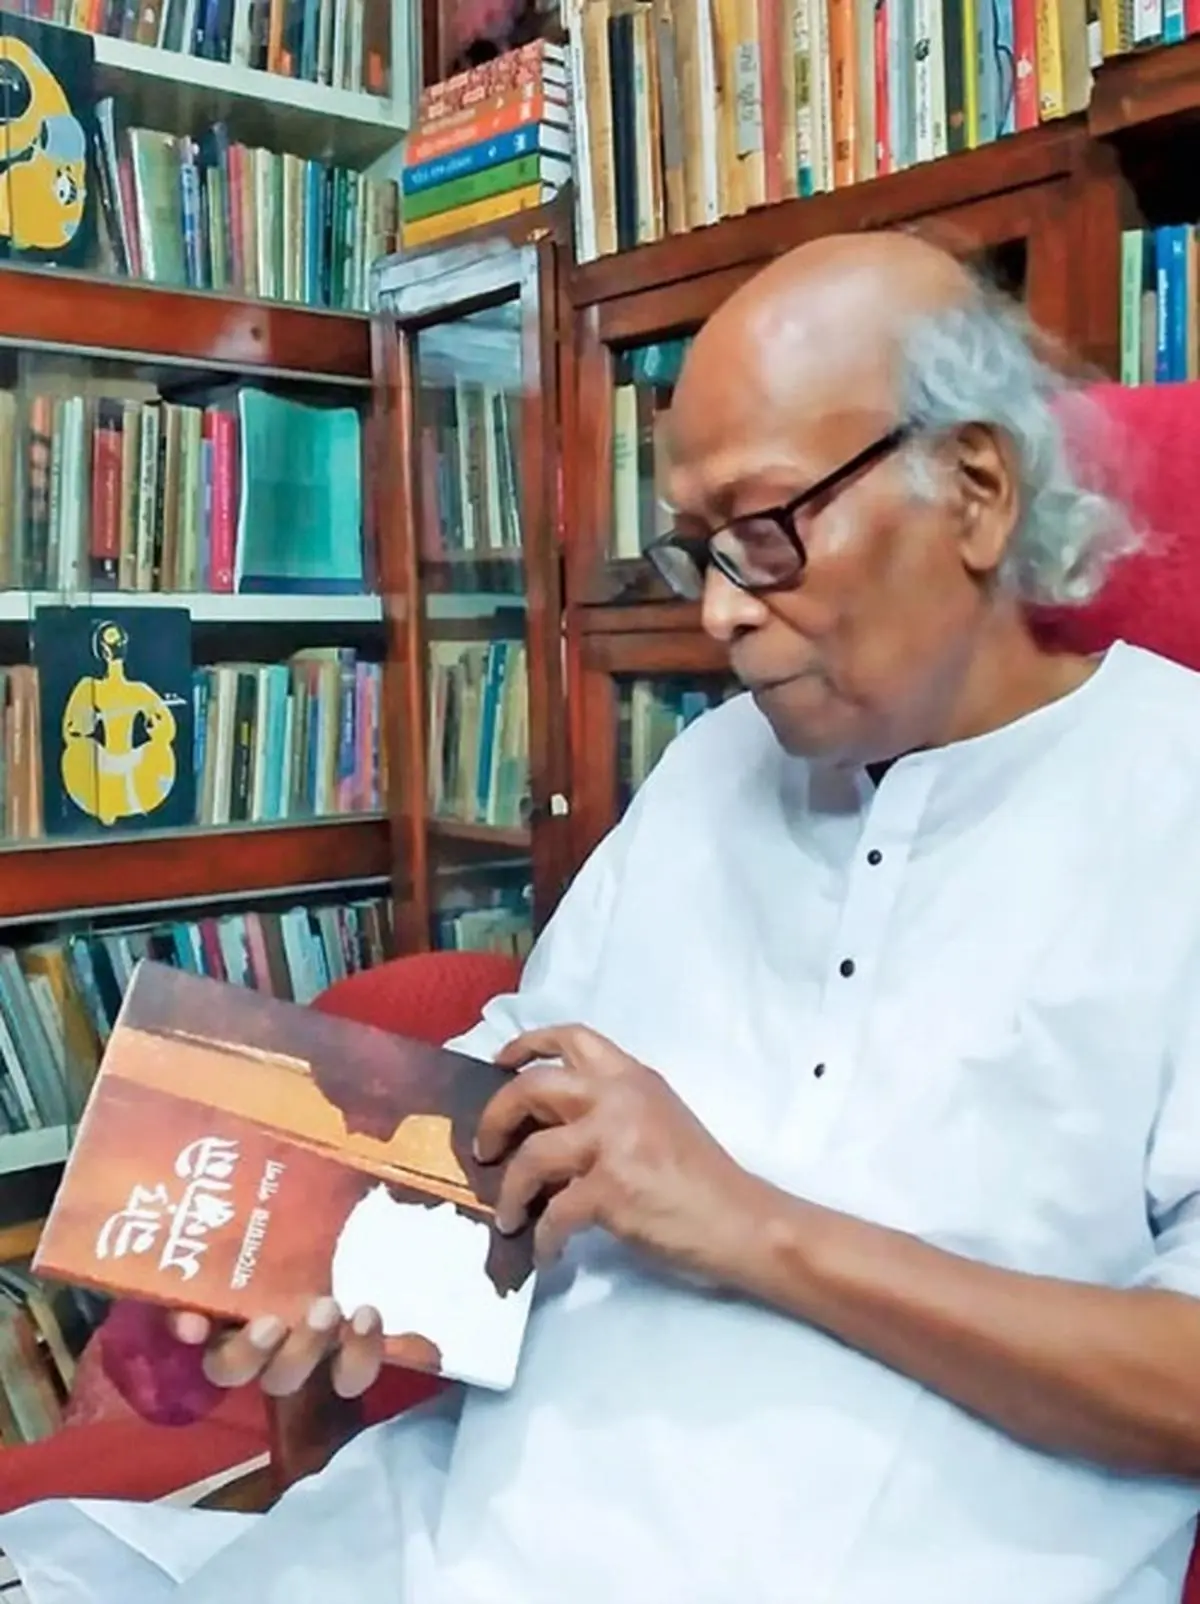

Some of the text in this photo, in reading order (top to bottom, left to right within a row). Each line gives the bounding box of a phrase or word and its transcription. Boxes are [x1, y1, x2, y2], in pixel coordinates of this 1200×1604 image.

[158, 1136, 241, 1282] সন্ধানী
[230, 1158, 288, 1290] আনোয়ার পাশা
